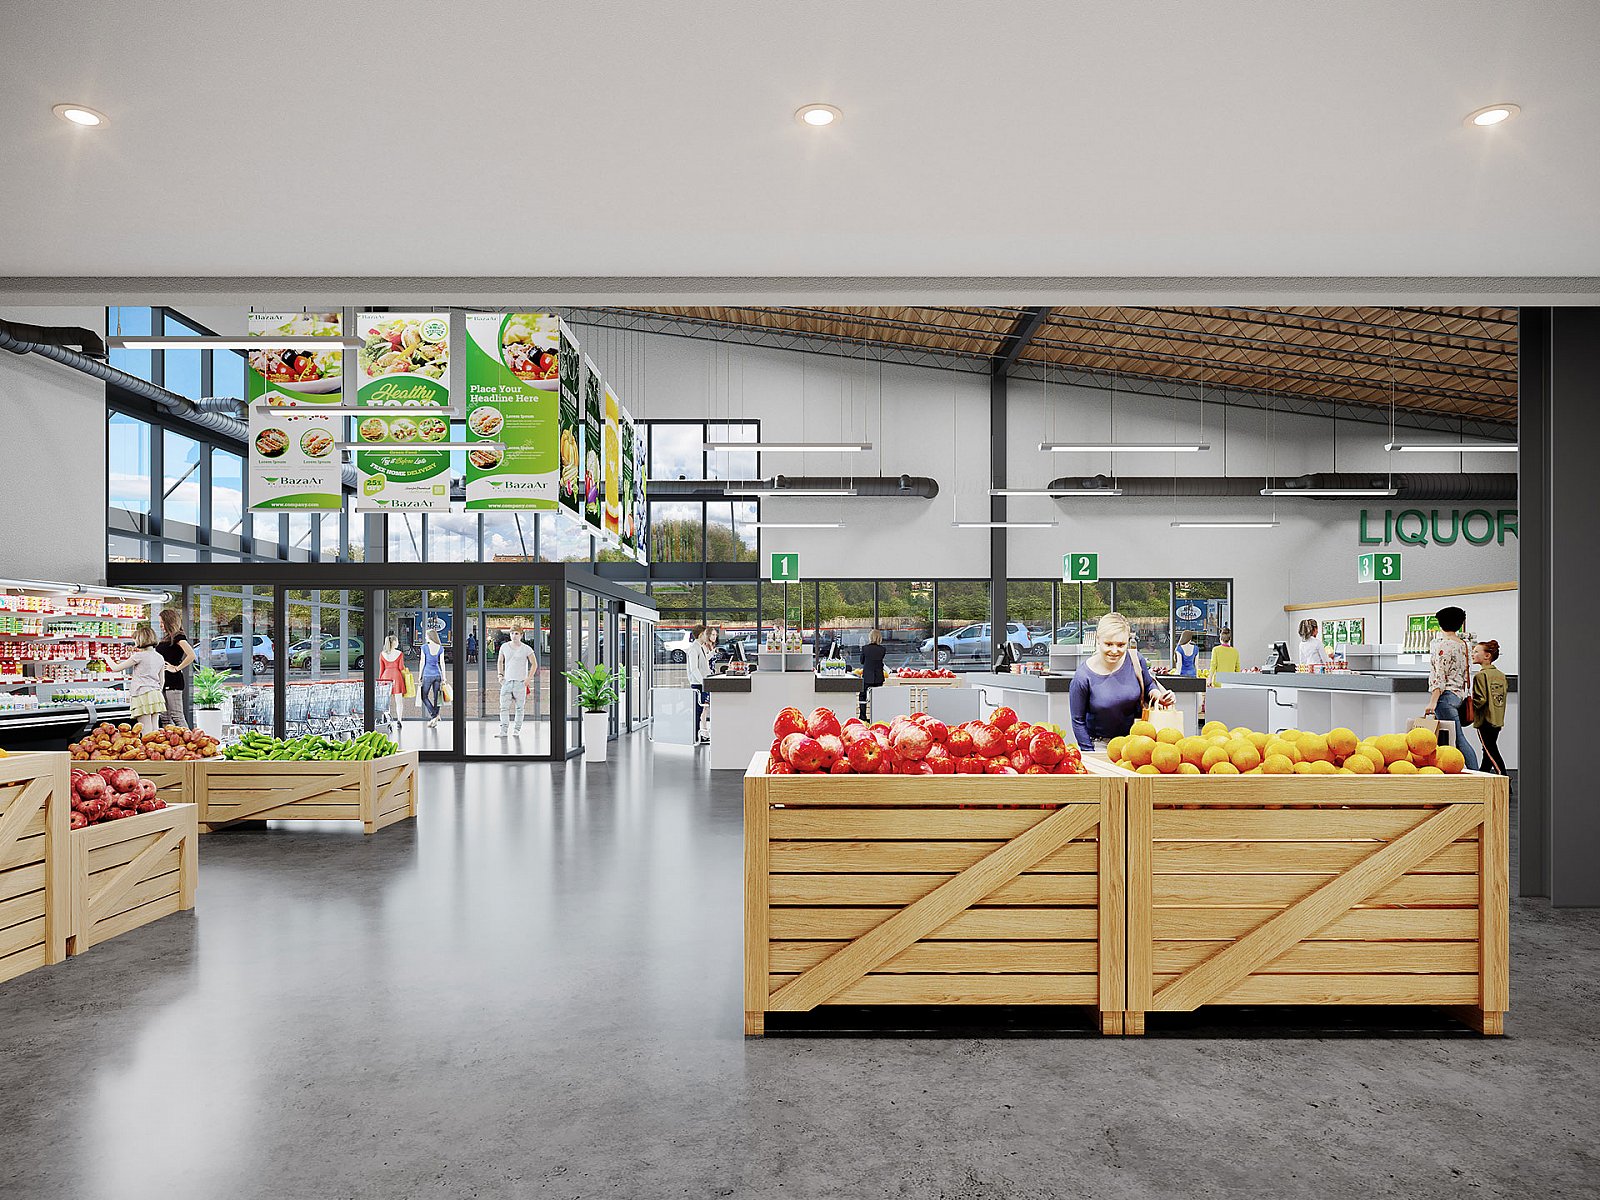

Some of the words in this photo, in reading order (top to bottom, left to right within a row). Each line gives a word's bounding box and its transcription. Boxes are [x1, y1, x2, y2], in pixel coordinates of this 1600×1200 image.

[371, 383, 437, 405] Healthy
[470, 385, 497, 393] Place
[499, 385, 522, 393] Your
[470, 394, 514, 403] Headline
[515, 394, 539, 403] Here
[407, 462, 437, 476] DELIVERY
[281, 477, 324, 485] BazaAr
[505, 481, 548, 489] BazaAr
[391, 499, 435, 507] BazaAr
[780, 556, 789, 576] 1
[1078, 556, 1090, 576] 2
[1362, 557, 1370, 577] 3
[1382, 556, 1393, 576] 3
